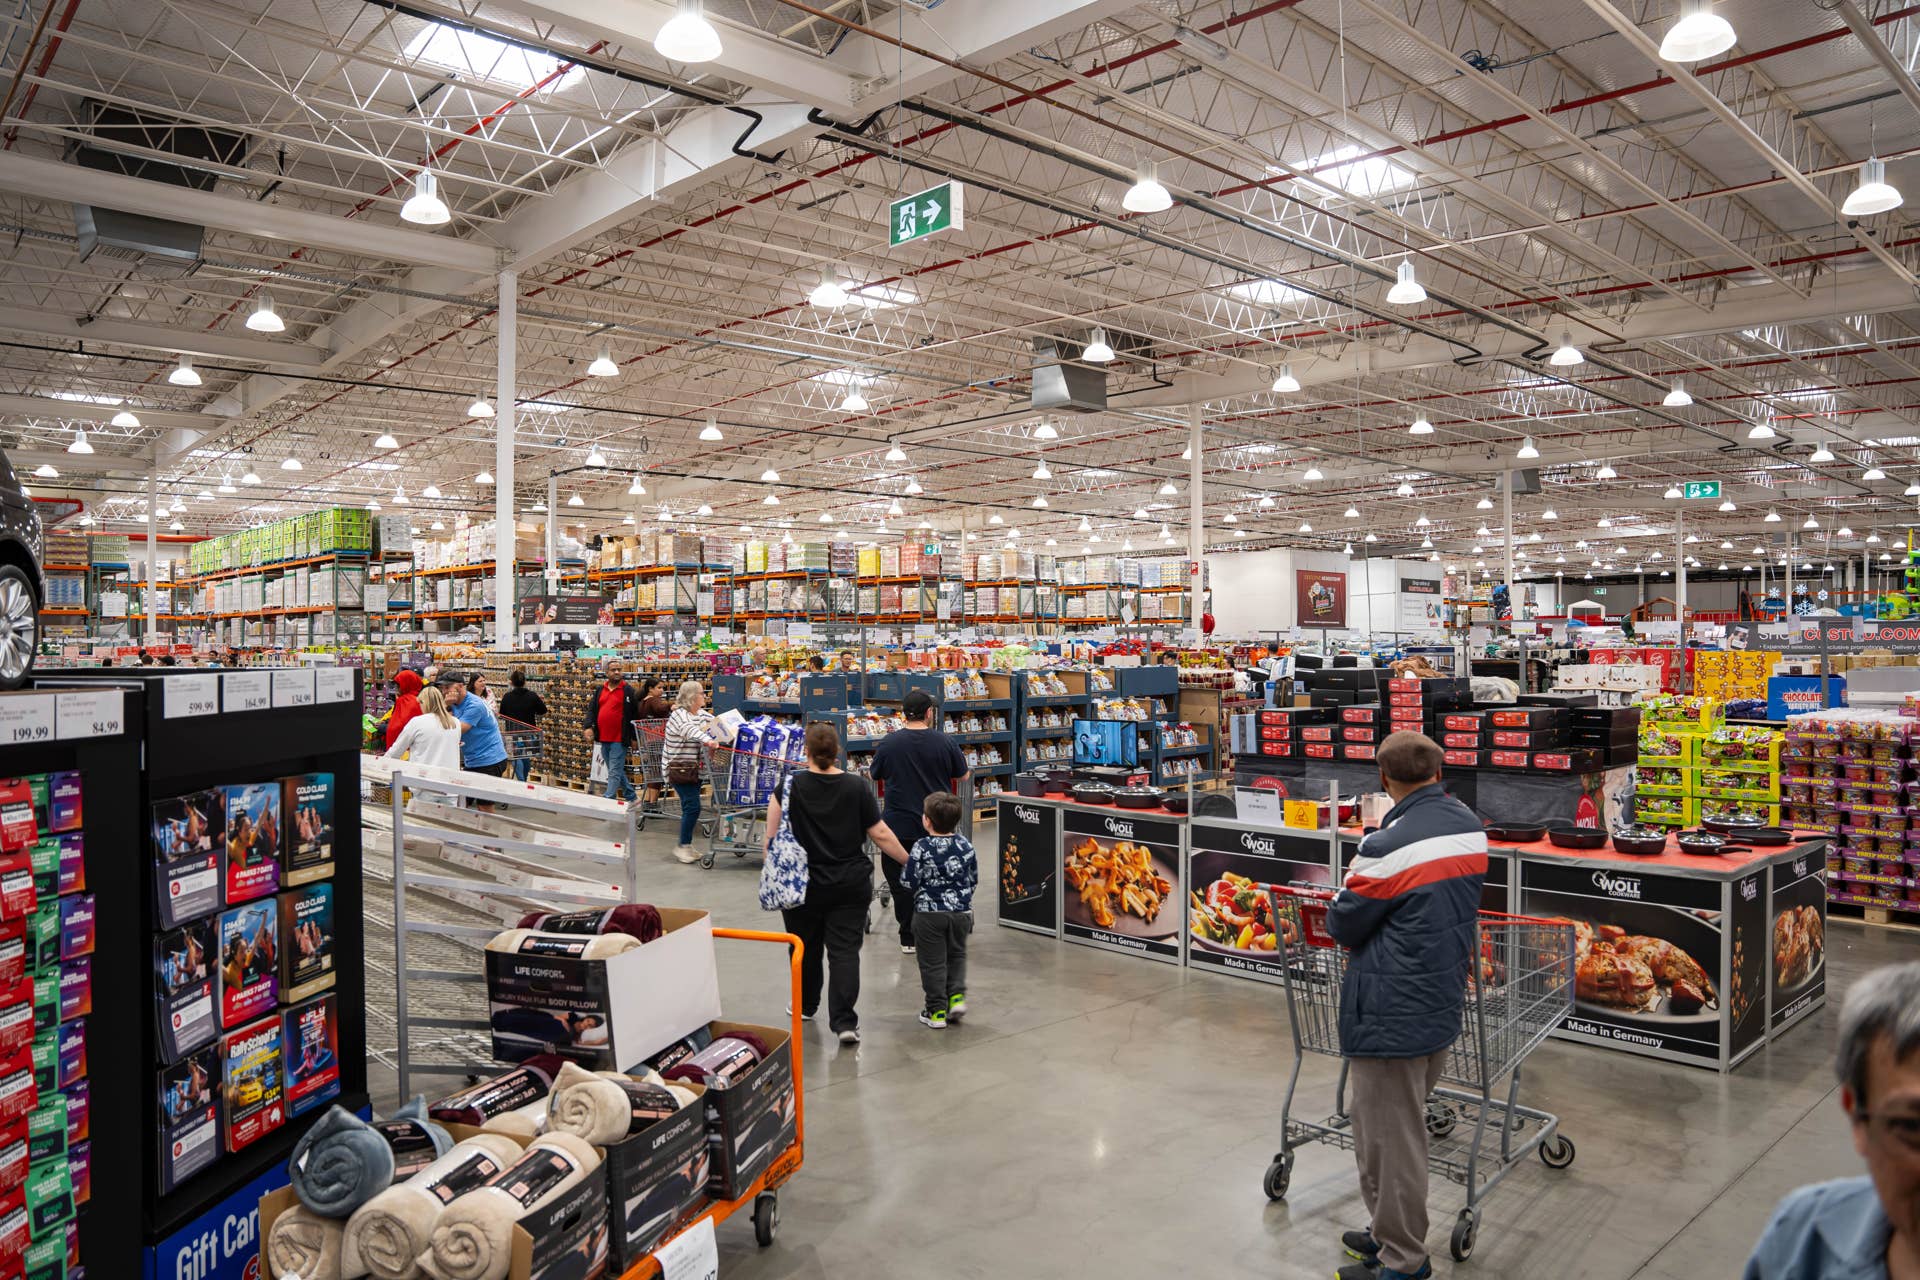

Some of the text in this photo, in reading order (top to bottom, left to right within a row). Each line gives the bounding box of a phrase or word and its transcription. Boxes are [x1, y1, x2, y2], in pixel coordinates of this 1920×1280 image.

[245, 697, 266, 709] 164.99
[1783, 692, 1822, 702] CHOCOLATE
[188, 701, 214, 714] 599.99
[13, 726, 48, 742] 199.99
[92, 721, 118, 734] 84.99
[296, 784, 327, 795] GOLD CLASS
[1018, 811, 1040, 821] WOLL
[1576, 816, 1596, 829] WOLL
[1109, 822, 1134, 834] WOLL
[1246, 839, 1275, 852] WOLL
[240, 869, 256, 878] PARKS
[260, 865, 273, 874] DAYS
[1600, 879, 1641, 894] WOLL
[1608, 891, 1641, 899] COOKWARE
[295, 896, 326, 911] GOLD CLASS
[1092, 931, 1148, 951] Made in Germany
[515, 966, 562, 979] LIFE COMFORT
[1224, 957, 1283, 975] Made in Germa
[236, 988, 253, 1001] PARKS
[258, 981, 271, 994] DAYS
[549, 998, 568, 1007] BODY
[569, 1000, 598, 1009] PILLOW
[1567, 1020, 1663, 1049] Made in Germany
[752, 1061, 780, 1091] LIFE COMFORT
[652, 1118, 691, 1149] LIFE COMFORT
[550, 1187, 593, 1226] LIFE COMFORT
[176, 1228, 218, 1280] Gift
